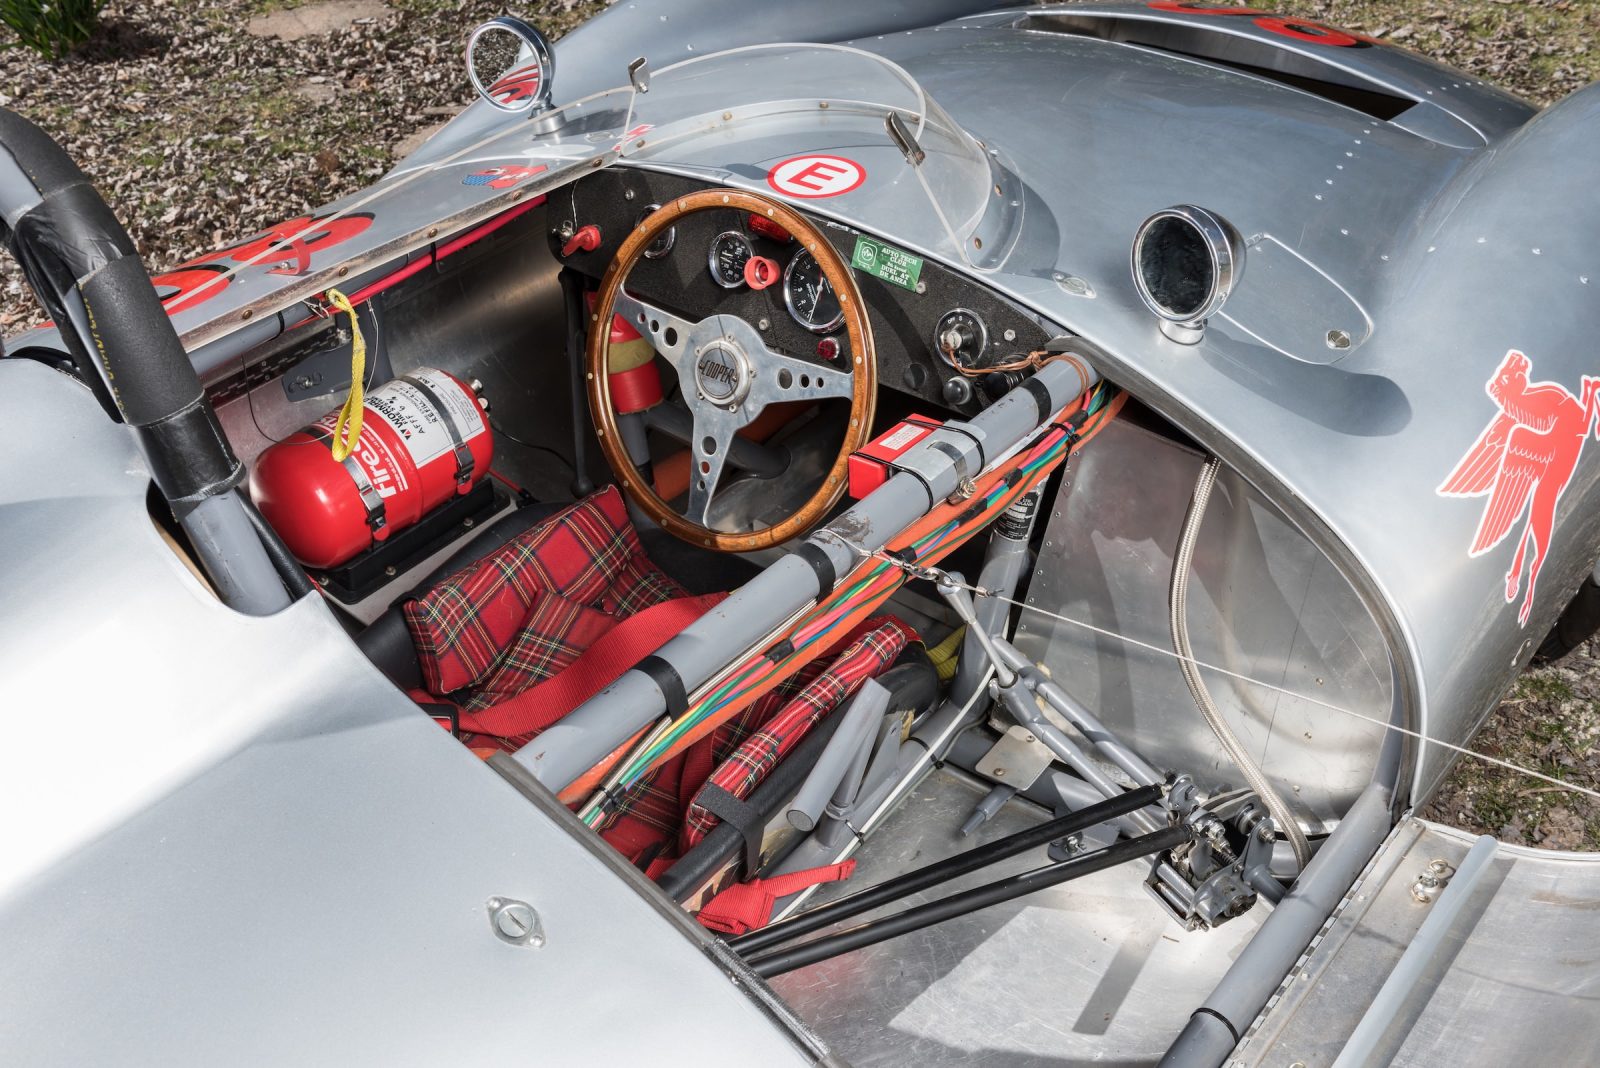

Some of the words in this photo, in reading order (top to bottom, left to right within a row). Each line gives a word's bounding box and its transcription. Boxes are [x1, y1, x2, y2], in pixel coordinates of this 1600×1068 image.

[786, 162, 848, 191] E
[882, 248, 900, 258] AUTO
[900, 254, 918, 266] TECH
[890, 256, 908, 267] CLUB
[881, 264, 898, 276] DUEL
[900, 272, 910, 280] AT
[890, 275, 908, 286] ANZA
[701, 360, 734, 384] COOPER
[363, 398, 403, 428] WORMALD
[395, 411, 408, 424] FIRE
[404, 415, 425, 434] AFFF
